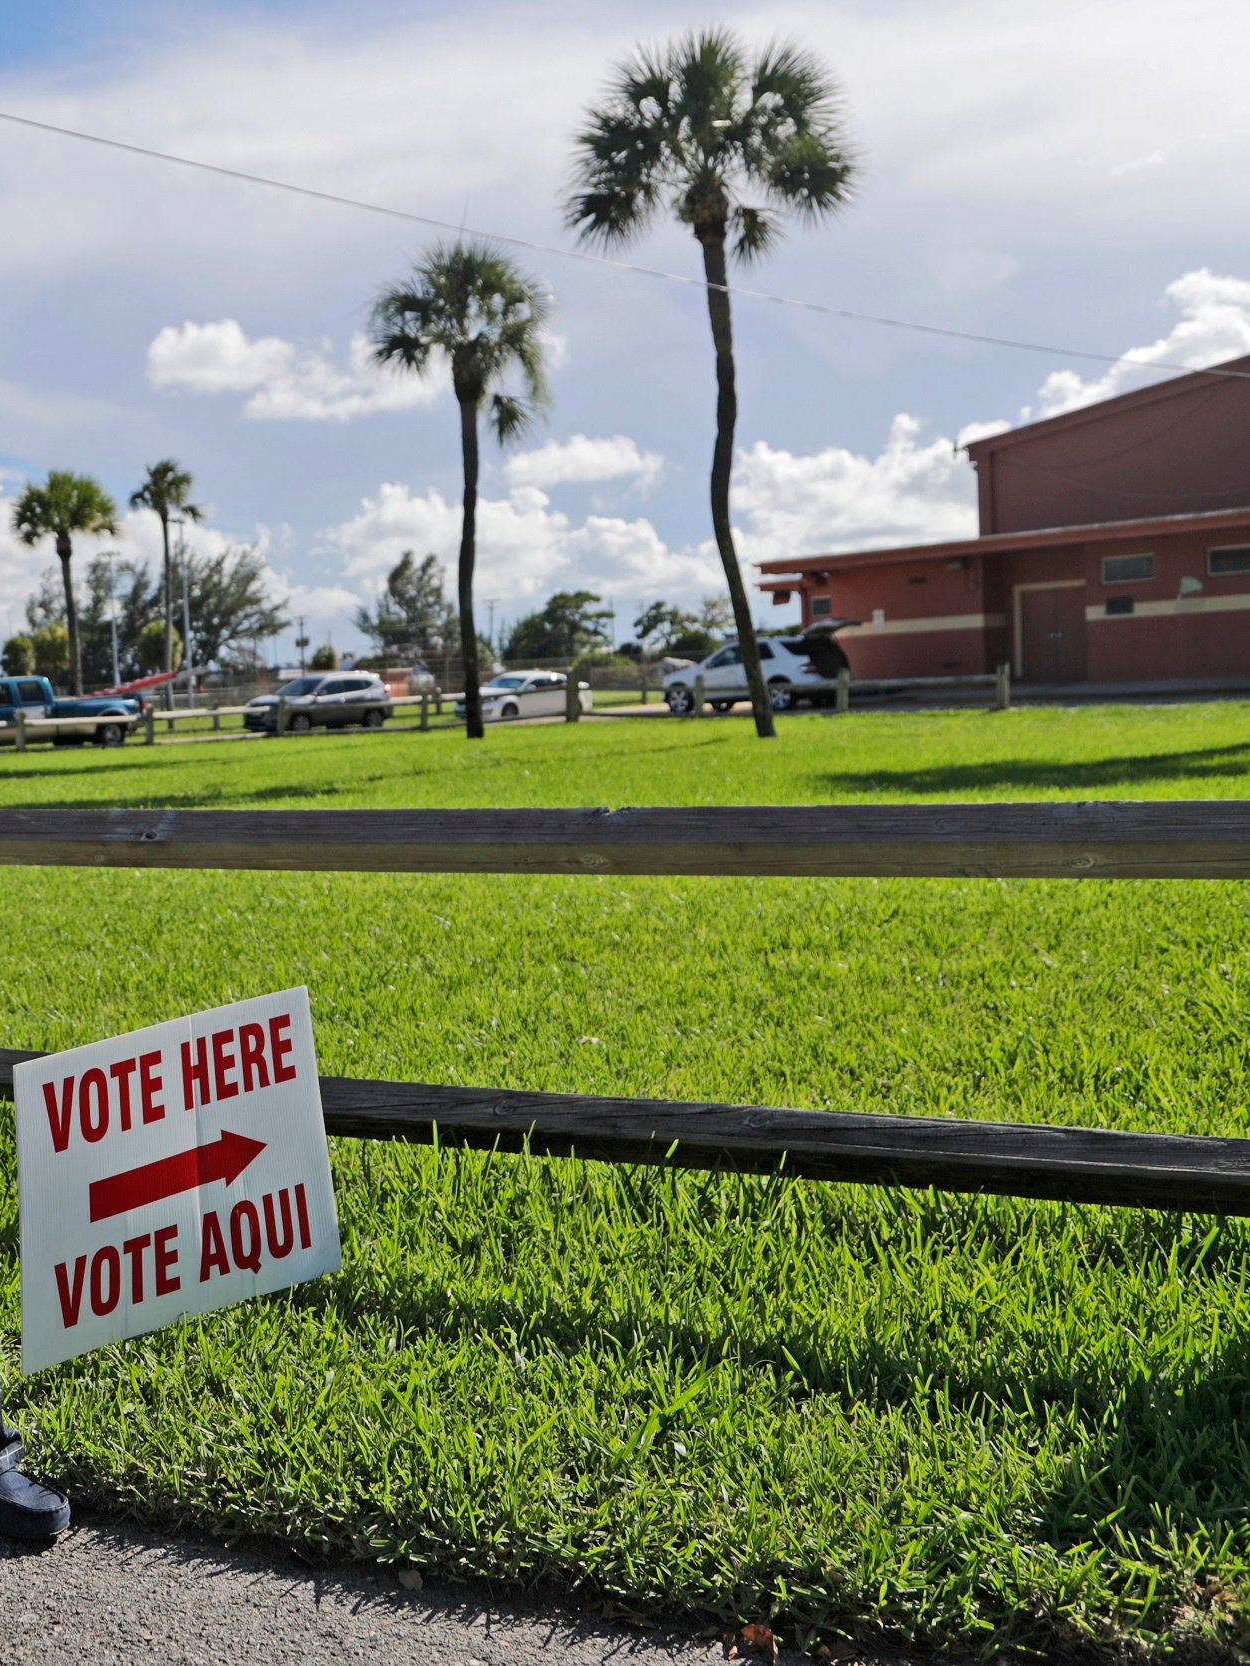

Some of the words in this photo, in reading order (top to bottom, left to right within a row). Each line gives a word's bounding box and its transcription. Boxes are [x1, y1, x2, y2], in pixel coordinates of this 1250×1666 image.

[42, 1050, 166, 1153] VOTE
[180, 1013, 297, 1111] HERE
[54, 1224, 181, 1329] VOTE
[199, 1183, 312, 1275] AQUI
